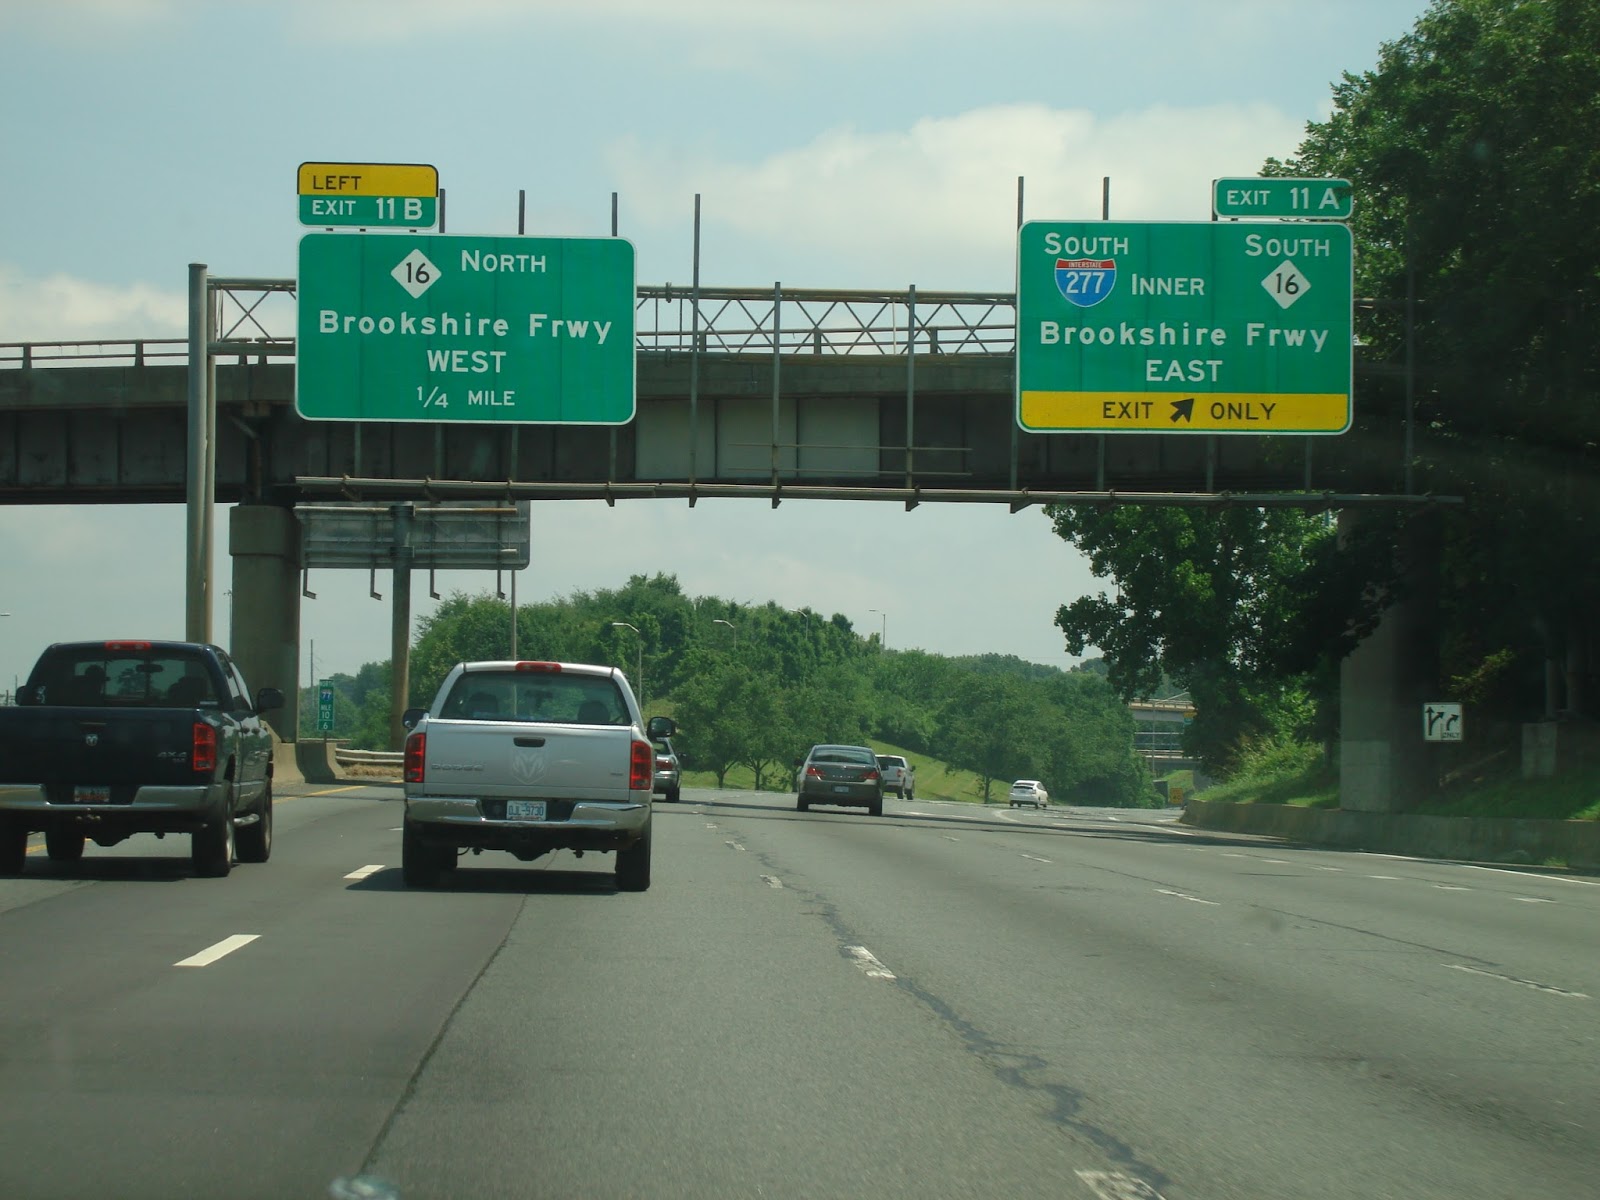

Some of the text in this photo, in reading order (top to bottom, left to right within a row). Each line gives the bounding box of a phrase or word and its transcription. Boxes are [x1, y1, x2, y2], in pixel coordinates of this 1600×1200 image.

[312, 175, 362, 190] LEFT
[311, 197, 423, 220] EXIT 11 B
[1226, 187, 1340, 210] EXIT 11 A
[1043, 232, 1129, 256] SOUTH
[1244, 233, 1331, 257] SOUTH
[405, 249, 547, 284] 16 NORTH
[1068, 261, 1102, 269] INTERSTATE
[1065, 271, 1205, 296] 277 INNER
[1275, 272, 1300, 295] 16
[319, 310, 612, 345] Brookshire Frwy
[1040, 321, 1329, 352] Brookshire Frwy
[426, 350, 507, 373] WEST
[1145, 359, 1223, 382] EAST
[416, 385, 516, 408] 1/4 MILE
[1102, 401, 1277, 420] EXIT ONLY
[321, 711, 330, 719] 10
[323, 722, 328, 730] 6
